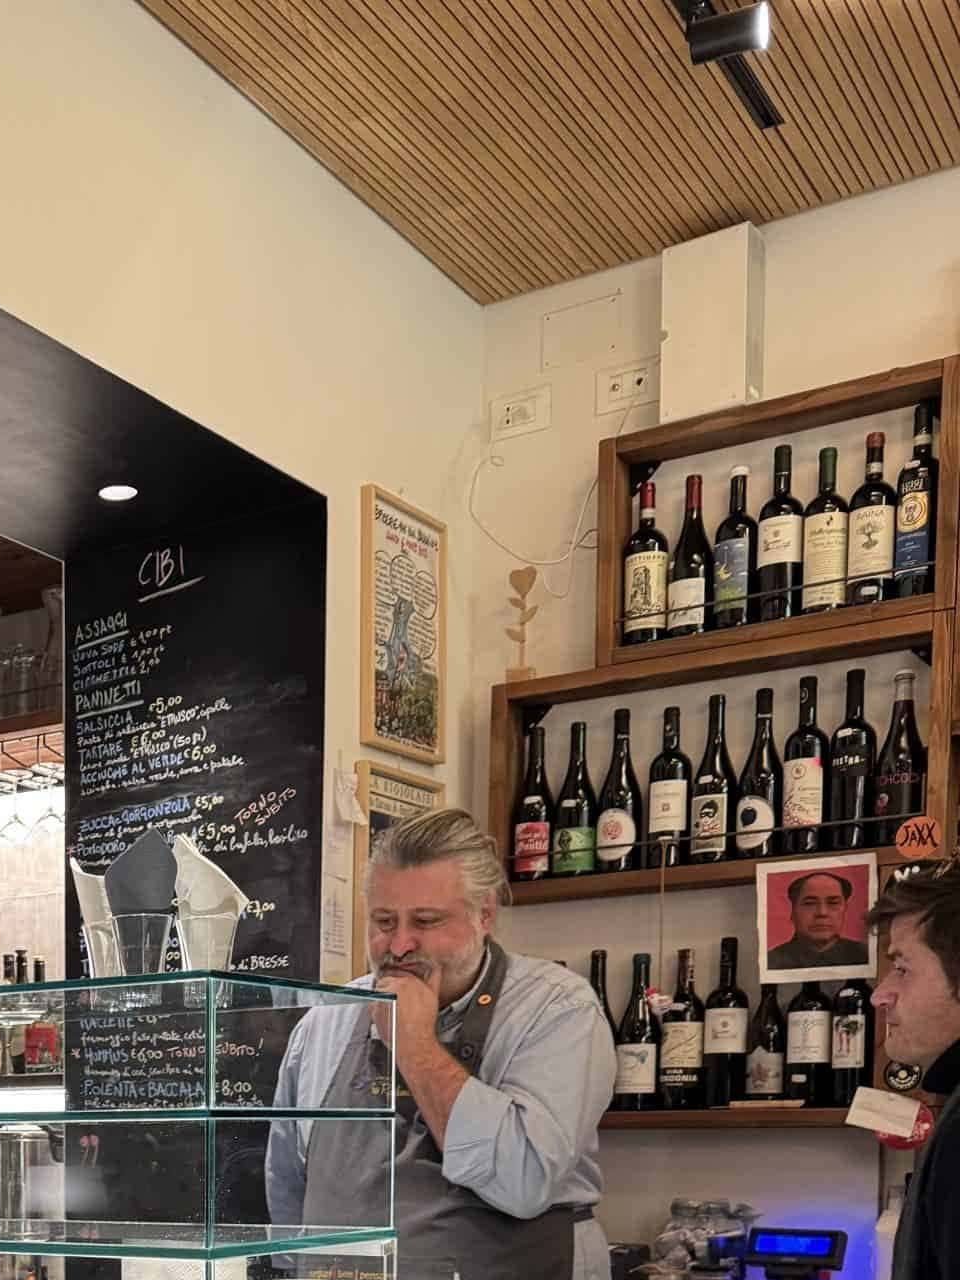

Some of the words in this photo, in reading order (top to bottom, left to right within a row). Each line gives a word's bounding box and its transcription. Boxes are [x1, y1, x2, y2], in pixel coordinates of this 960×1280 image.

[139, 545, 185, 585] CIBI
[74, 611, 127, 645] ASSAGGI
[76, 679, 142, 713] PANINETTI
[76, 710, 133, 737] SALSICCIA
[132, 763, 146, 776] AL
[148, 752, 184, 771] VERDE
[121, 797, 192, 825] GORGONZOLA
[234, 791, 277, 826] TORNO
[254, 787, 297, 827] SUBITO
[898, 821, 938, 849] JAXX
[250, 955, 289, 971] BRESSE
